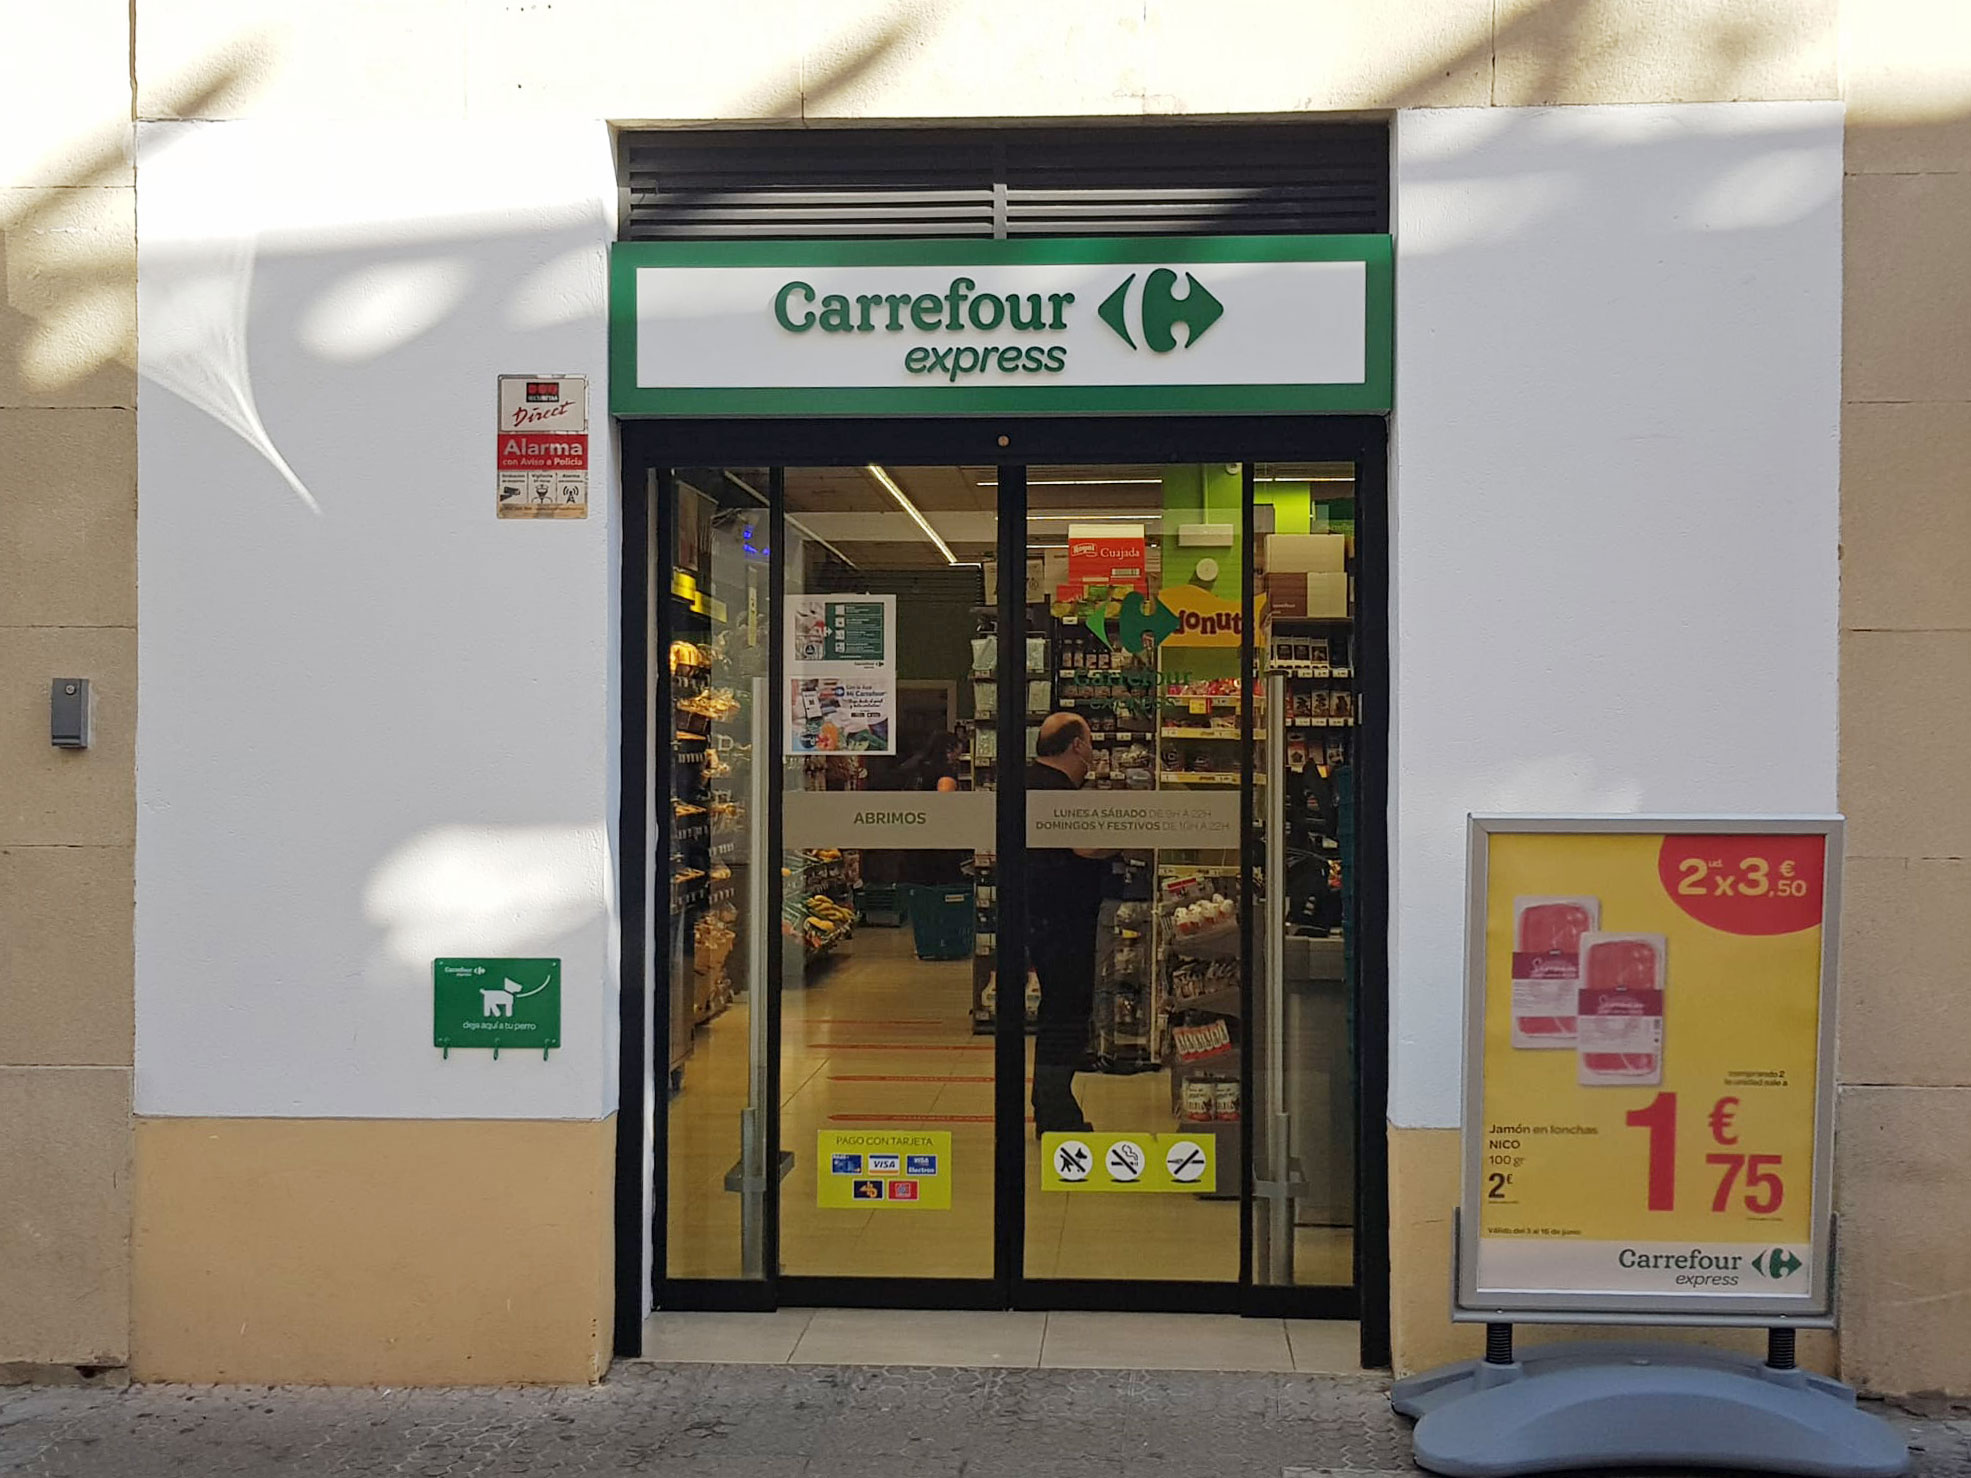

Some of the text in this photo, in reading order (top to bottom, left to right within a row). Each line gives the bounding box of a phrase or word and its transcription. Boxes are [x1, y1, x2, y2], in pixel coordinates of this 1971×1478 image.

[774, 277, 1075, 335] Carrefour
[905, 342, 1066, 382] express
[512, 400, 577, 428] Direct
[503, 438, 583, 456] Alarma
[520, 458, 545, 466] Aviso
[1100, 547, 1140, 560] Cuajada
[853, 812, 926, 825] ABRIMOS
[1053, 809, 1089, 818] LUNES
[1090, 809, 1098, 818] A
[1101, 806, 1147, 818] SÁBADO
[1036, 821, 1096, 831] DOMINGOS
[1098, 821, 1106, 831] Y
[1107, 821, 1161, 831] FESTIVOS
[1489, 1124, 1599, 1135] Jamón en lonchas
[836, 1136, 934, 1147] PAGO CON TARJETA
[1489, 1139, 1521, 1150] NICO
[1626, 1091, 1677, 1212] 1
[1705, 1153, 1784, 1214] 75
[873, 1160, 896, 1169] VISA
[1489, 1155, 1512, 1165] 100
[1618, 1249, 1742, 1270] Carrefour
[1675, 1273, 1739, 1288] express
